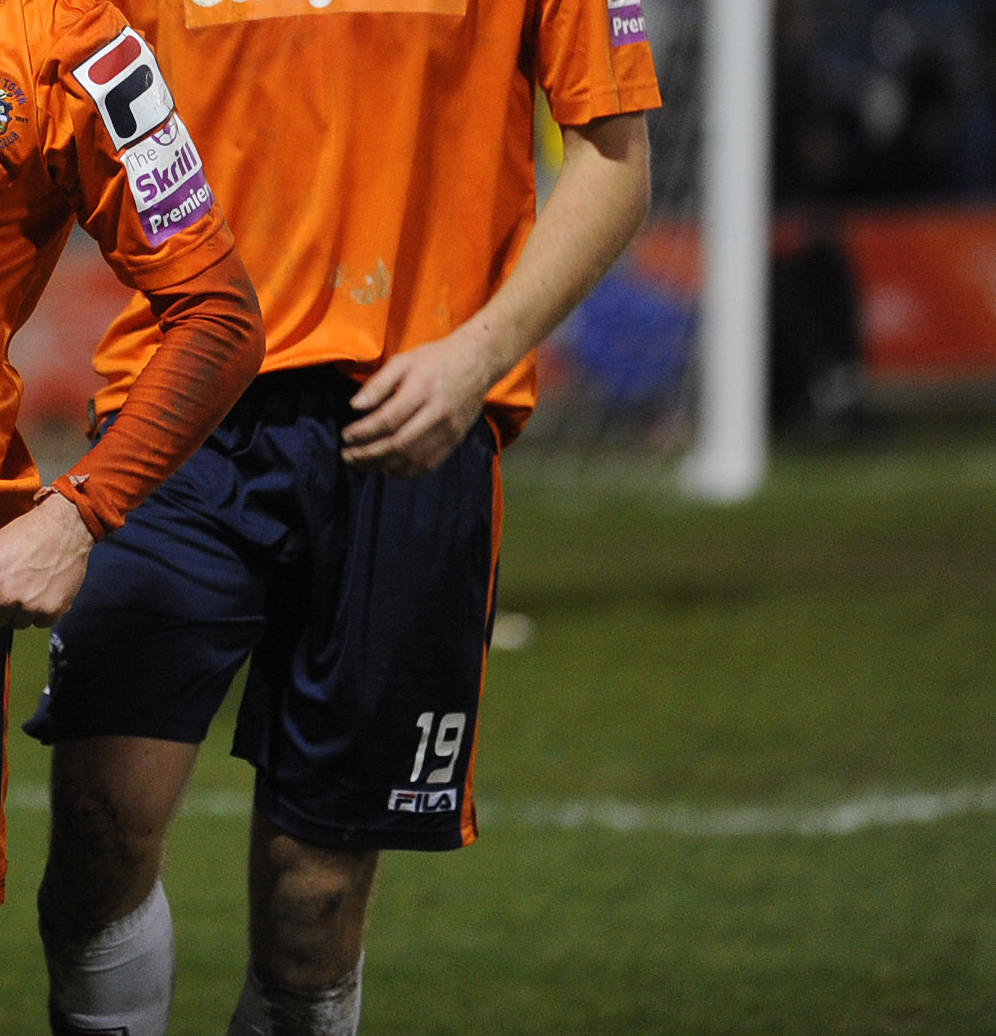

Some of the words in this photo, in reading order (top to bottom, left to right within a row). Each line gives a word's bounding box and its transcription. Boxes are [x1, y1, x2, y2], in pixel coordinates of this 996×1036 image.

[4, 77, 28, 106] TOWN
[125, 147, 159, 173] The
[135, 141, 198, 204] Skrill
[409, 712, 467, 784] 19
[394, 792, 452, 812] FILA
